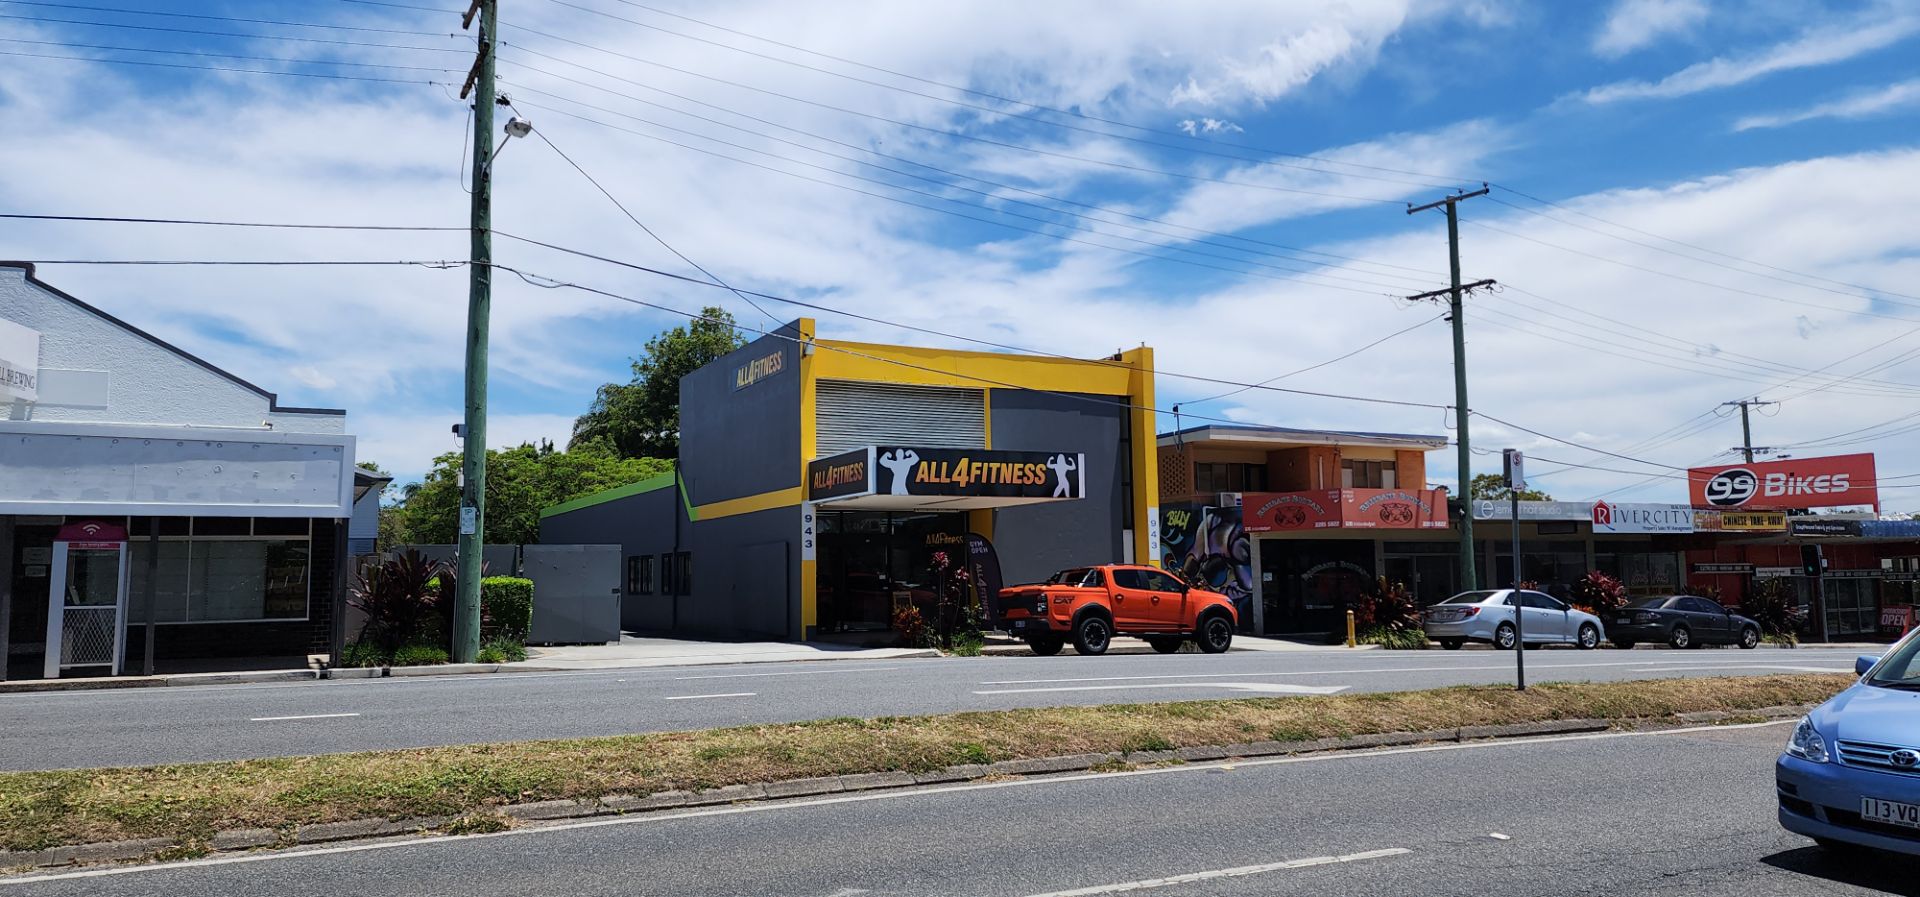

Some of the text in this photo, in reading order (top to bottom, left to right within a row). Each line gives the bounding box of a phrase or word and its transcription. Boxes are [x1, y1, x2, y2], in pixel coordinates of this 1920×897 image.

[736, 351, 782, 388] ALL4FITNESS
[813, 461, 864, 490] ALL4FITNESS
[914, 457, 1047, 488] ALL4FITNESS
[1707, 475, 1752, 500] 99
[804, 514, 813, 548] 943
[1723, 516, 1747, 526] CHINESE
[1882, 614, 1907, 626] OPEN
